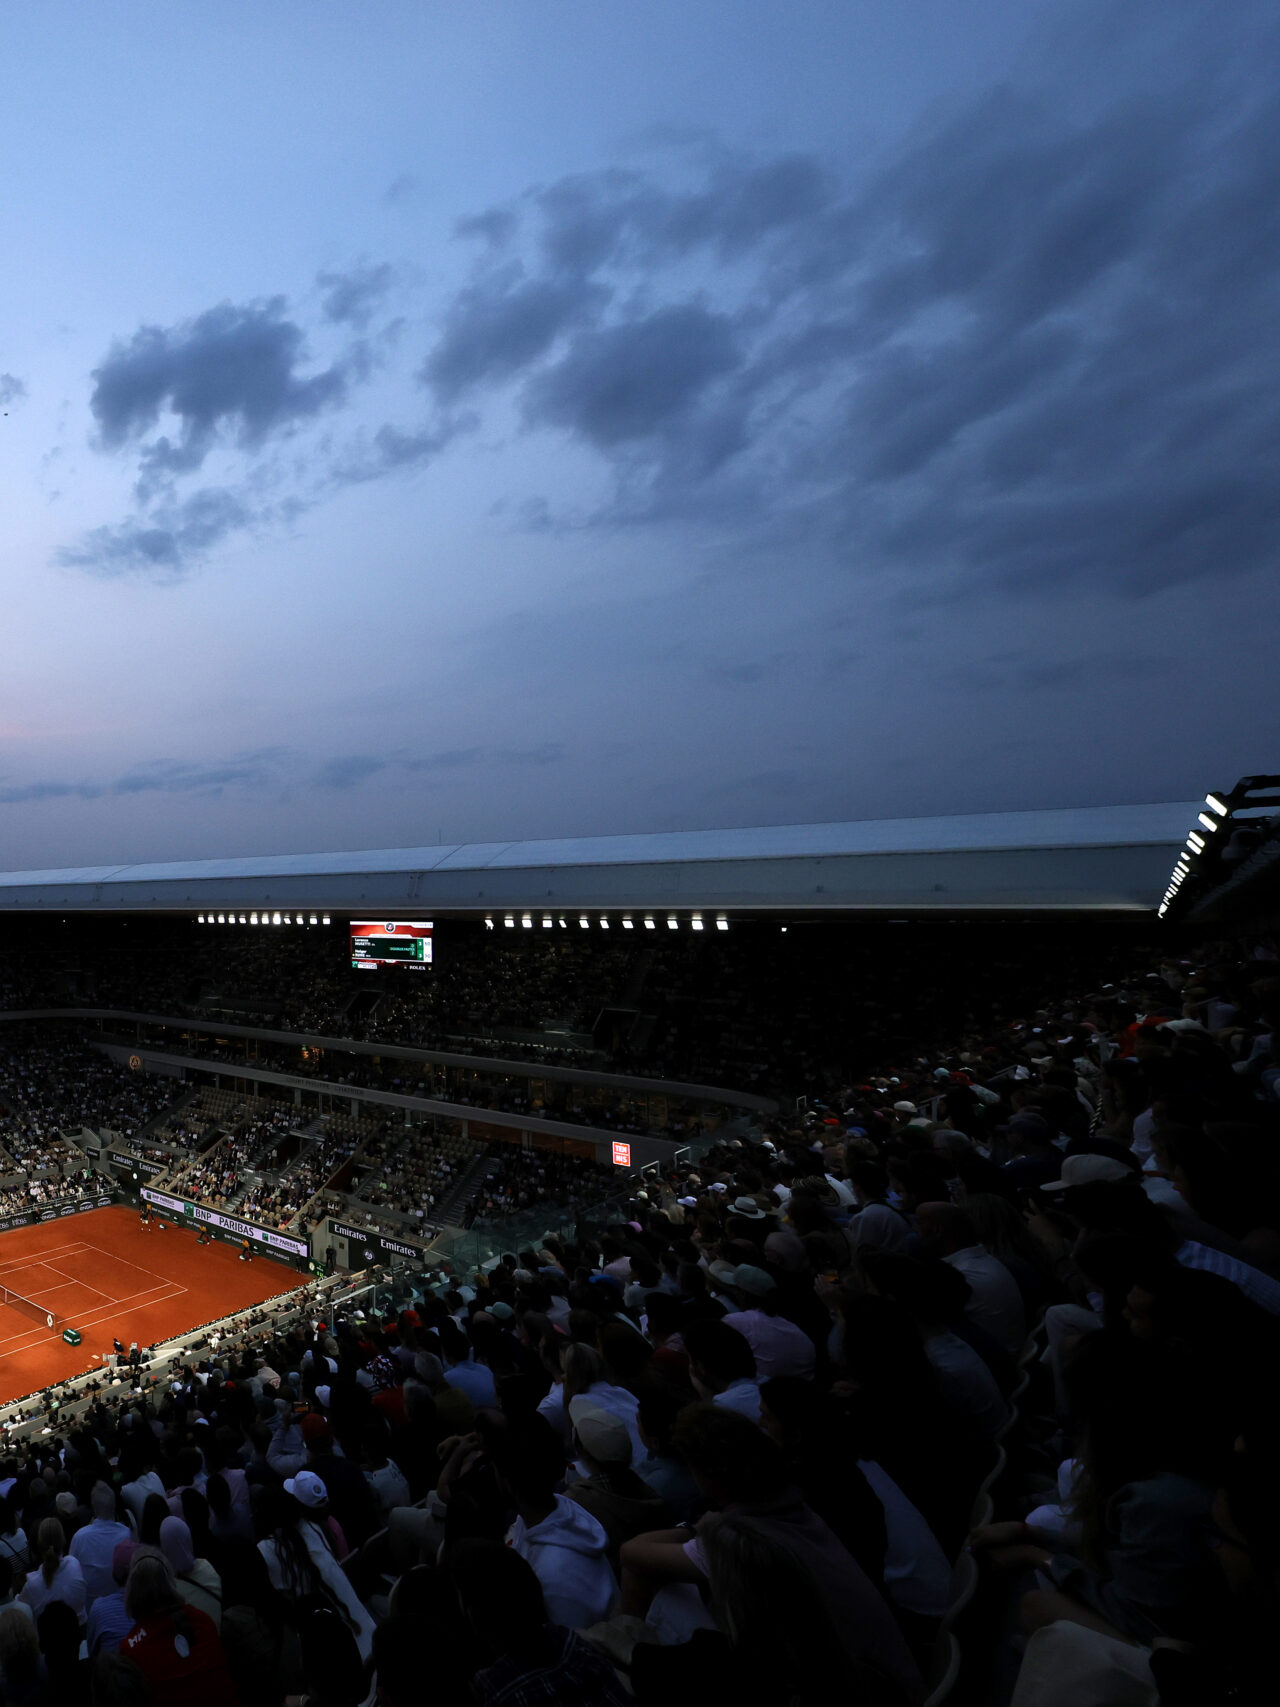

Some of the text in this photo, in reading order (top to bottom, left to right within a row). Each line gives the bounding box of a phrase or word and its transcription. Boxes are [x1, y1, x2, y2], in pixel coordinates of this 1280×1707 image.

[113, 1153, 134, 1167] Emirates
[139, 1162, 161, 1174] Emirates
[195, 1208, 254, 1237] BNP PARIBAS
[334, 1223, 367, 1242] Emirates
[279, 1238, 299, 1250] PARIBAS
[380, 1238, 417, 1257] Emirates
